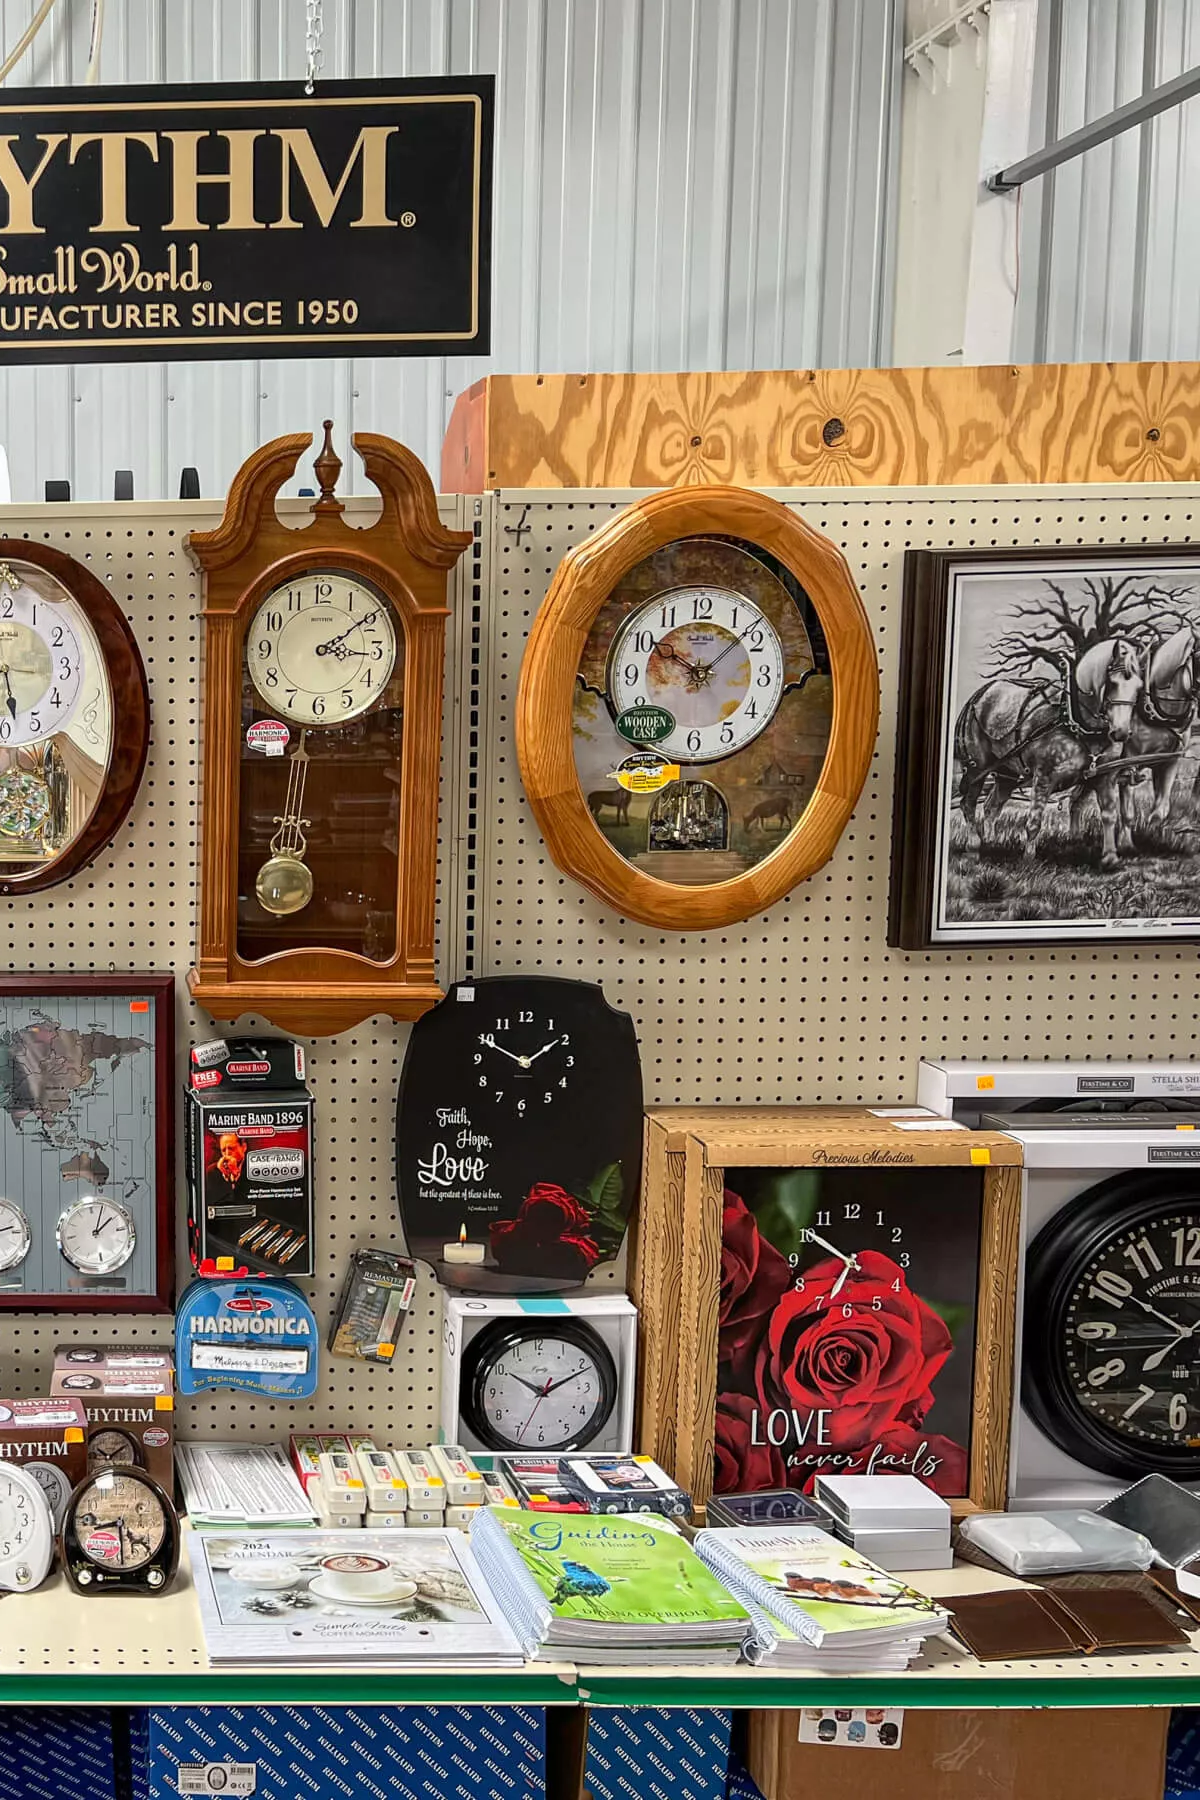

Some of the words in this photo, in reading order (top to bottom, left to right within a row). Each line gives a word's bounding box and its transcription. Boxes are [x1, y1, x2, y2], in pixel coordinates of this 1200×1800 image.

[82, 243, 201, 293] World
[191, 300, 282, 328] SINCE
[295, 298, 359, 326] 1950
[314, 583, 332, 604] 12
[691, 598, 713, 620] 12
[633, 631, 655, 653] 10
[624, 716, 667, 728] WOODEN
[632, 727, 657, 738] CASE
[195, 1070, 217, 1083] FREE
[230, 1064, 252, 1072] MARINE
[252, 1063, 268, 1072] BAND
[206, 1113, 247, 1126] MARINE
[248, 1112, 274, 1125] BAND
[276, 1111, 304, 1125] 1896
[436, 1107, 471, 1128] Faith,
[456, 1128, 492, 1152] Hope,
[250, 1155, 270, 1163] CASE
[418, 1142, 490, 1186] Love
[812, 1149, 860, 1164] Precious
[863, 1149, 914, 1165] Melodies
[843, 1204, 860, 1219] 12
[1124, 1237, 1163, 1279] 11
[1171, 1228, 1200, 1266] 12
[1088, 1269, 1133, 1309] 10
[190, 1316, 310, 1335] HARMONICA
[1077, 1321, 1117, 1340] 9
[207, 1375, 245, 1386] Beginning
[246, 1379, 267, 1390] Music
[13, 1399, 70, 1407] RHYTHM
[1123, 1384, 1155, 1420] 7
[1169, 1393, 1187, 1431] 6
[87, 1408, 154, 1423] HYTHM
[750, 1409, 832, 1447] LOVE
[786, 1450, 863, 1470] never
[865, 1440, 943, 1477] fails
[528, 1521, 656, 1551] Guiding
[224, 1551, 294, 1560] CALENDAR
[152, 1712, 183, 1743] RHYTHM
[512, 1730, 544, 1760] RHYTHM
[676, 1726, 707, 1757] RHYTHM
